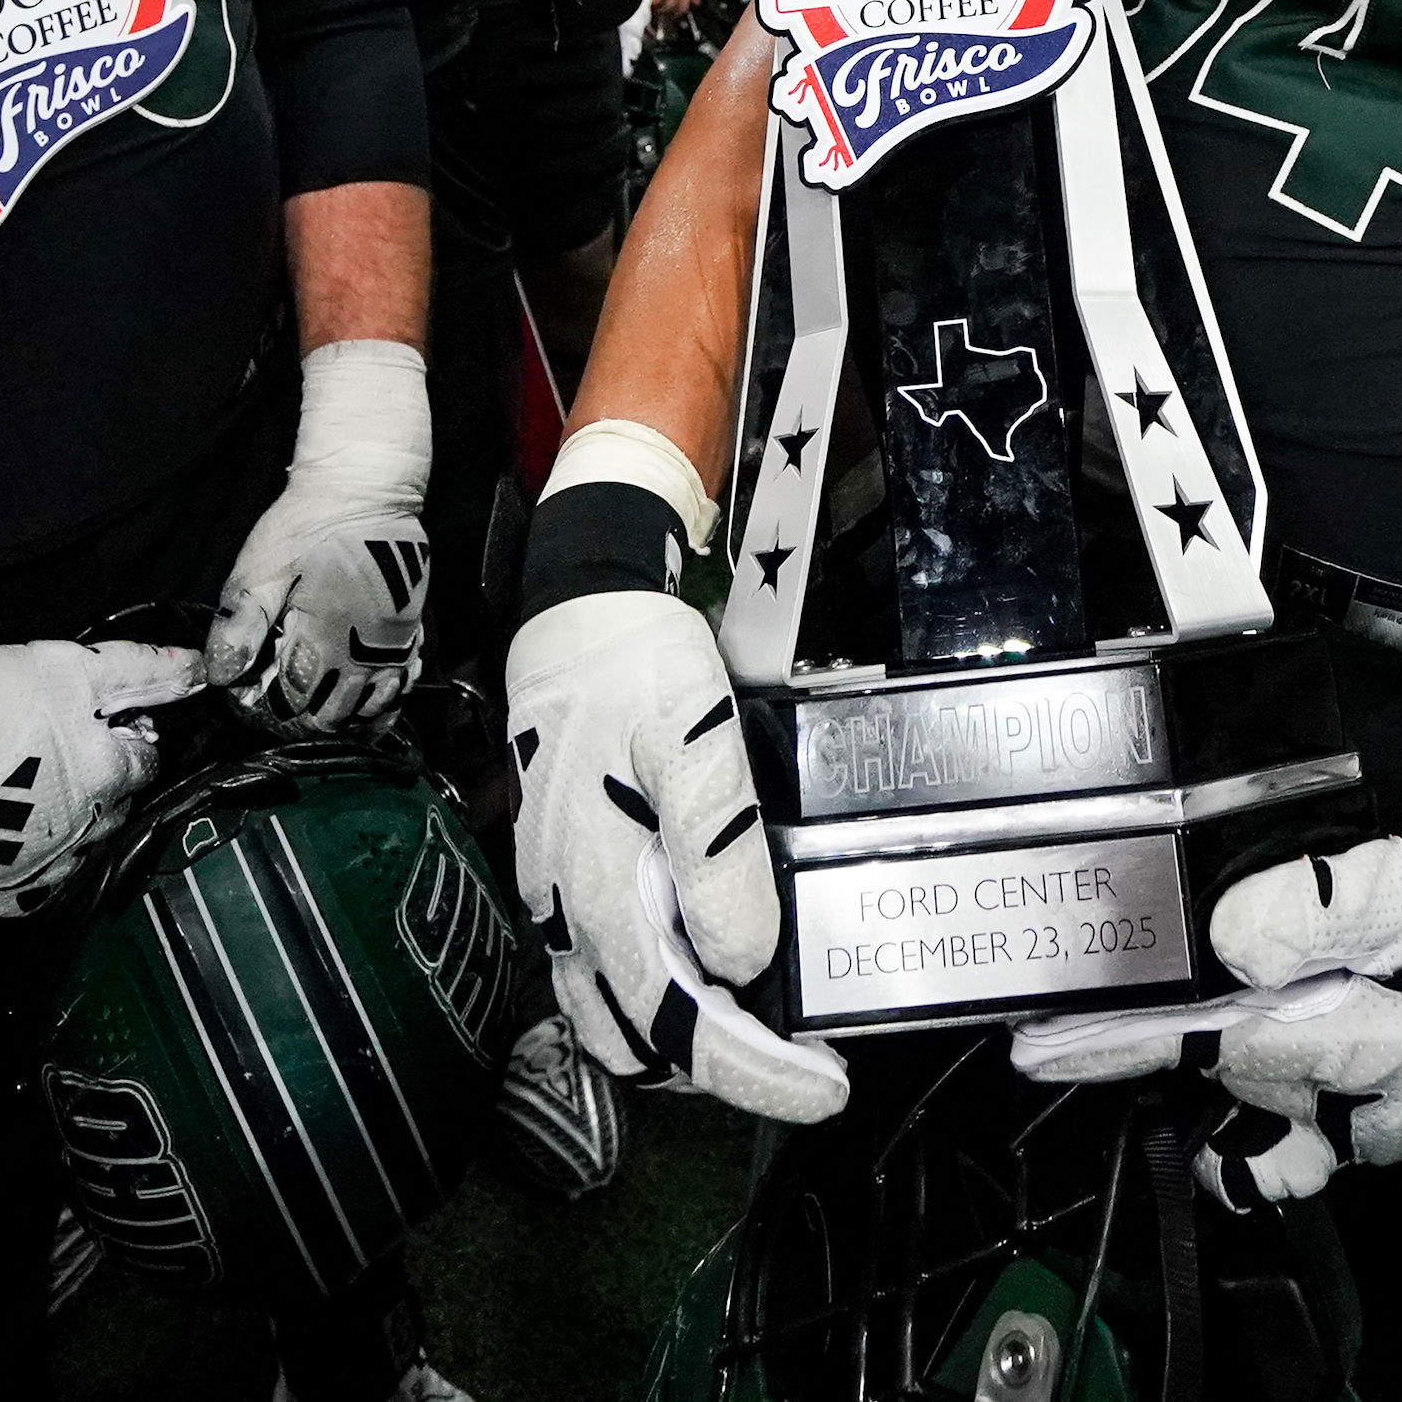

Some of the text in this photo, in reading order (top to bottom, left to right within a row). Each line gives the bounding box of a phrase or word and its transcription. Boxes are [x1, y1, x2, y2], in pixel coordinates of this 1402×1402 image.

[831, 34, 1023, 129] Frisco
[894, 75, 992, 117] BOWL
[32, 92, 122, 149] BOWL
[806, 685, 1154, 798] CHAMPION
[859, 867, 1118, 923] FORD CENTER
[826, 916, 1158, 980] DECEMBER 23, 2025
